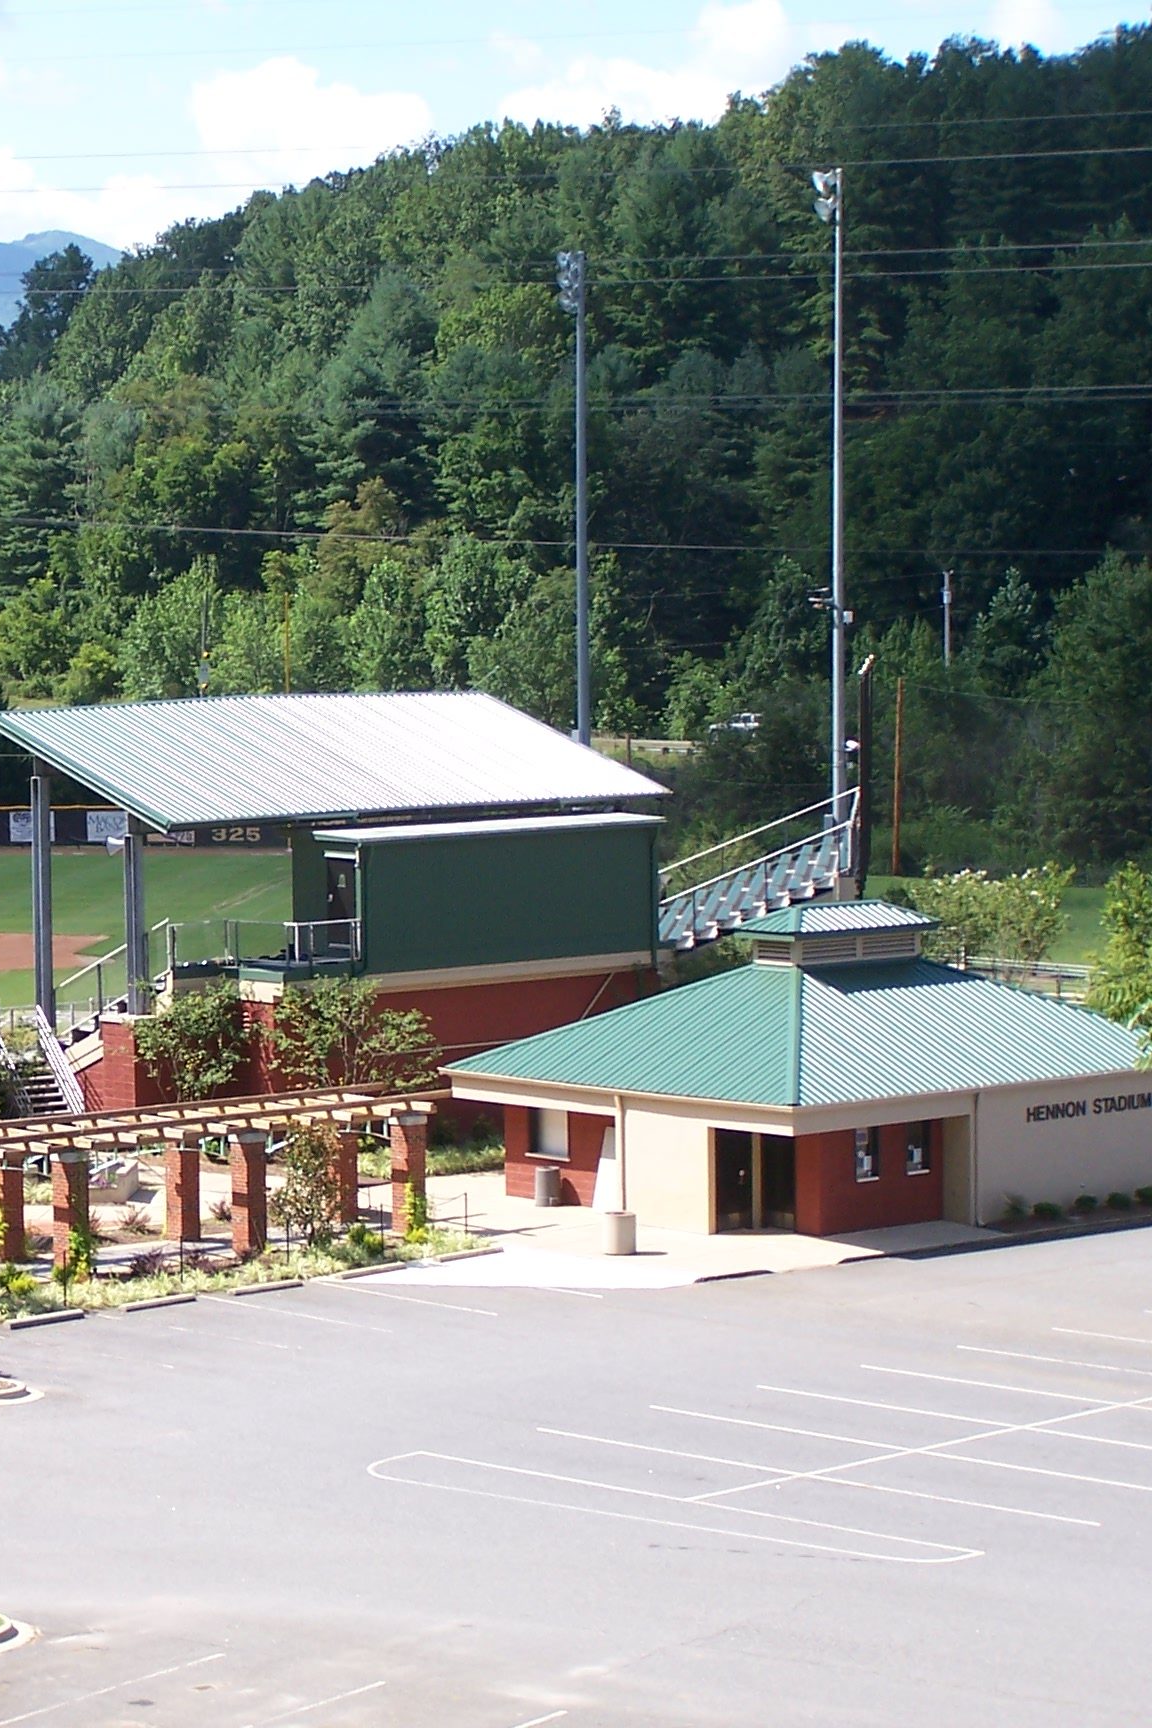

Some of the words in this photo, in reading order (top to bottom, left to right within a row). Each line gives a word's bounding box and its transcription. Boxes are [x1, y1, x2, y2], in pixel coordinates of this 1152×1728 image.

[212, 827, 261, 841] 325
[1027, 1101, 1086, 1122] HENNON
[1093, 1093, 1152, 1114] STADIUM
